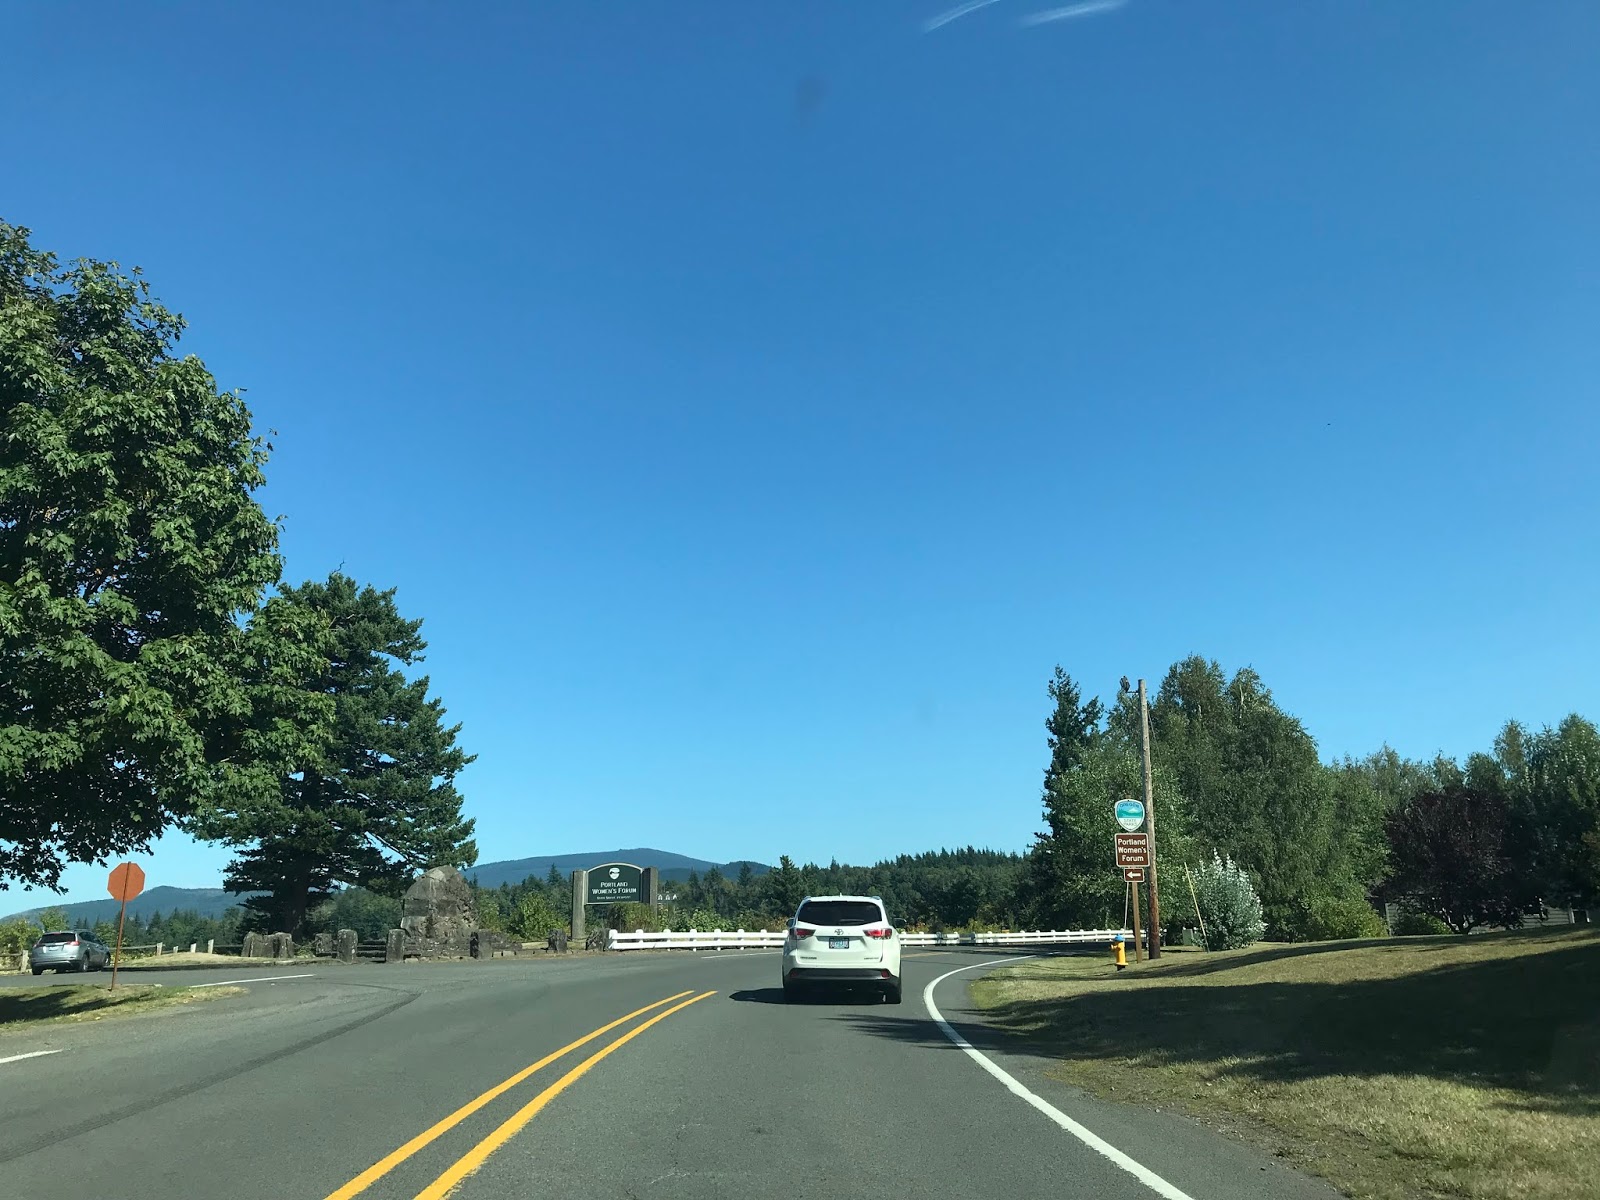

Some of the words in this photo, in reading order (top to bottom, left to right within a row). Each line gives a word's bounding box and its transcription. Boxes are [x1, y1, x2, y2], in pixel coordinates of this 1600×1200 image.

[1117, 838, 1146, 846] Portland
[1117, 846, 1147, 854] Women's
[1121, 854, 1144, 862] Forum
